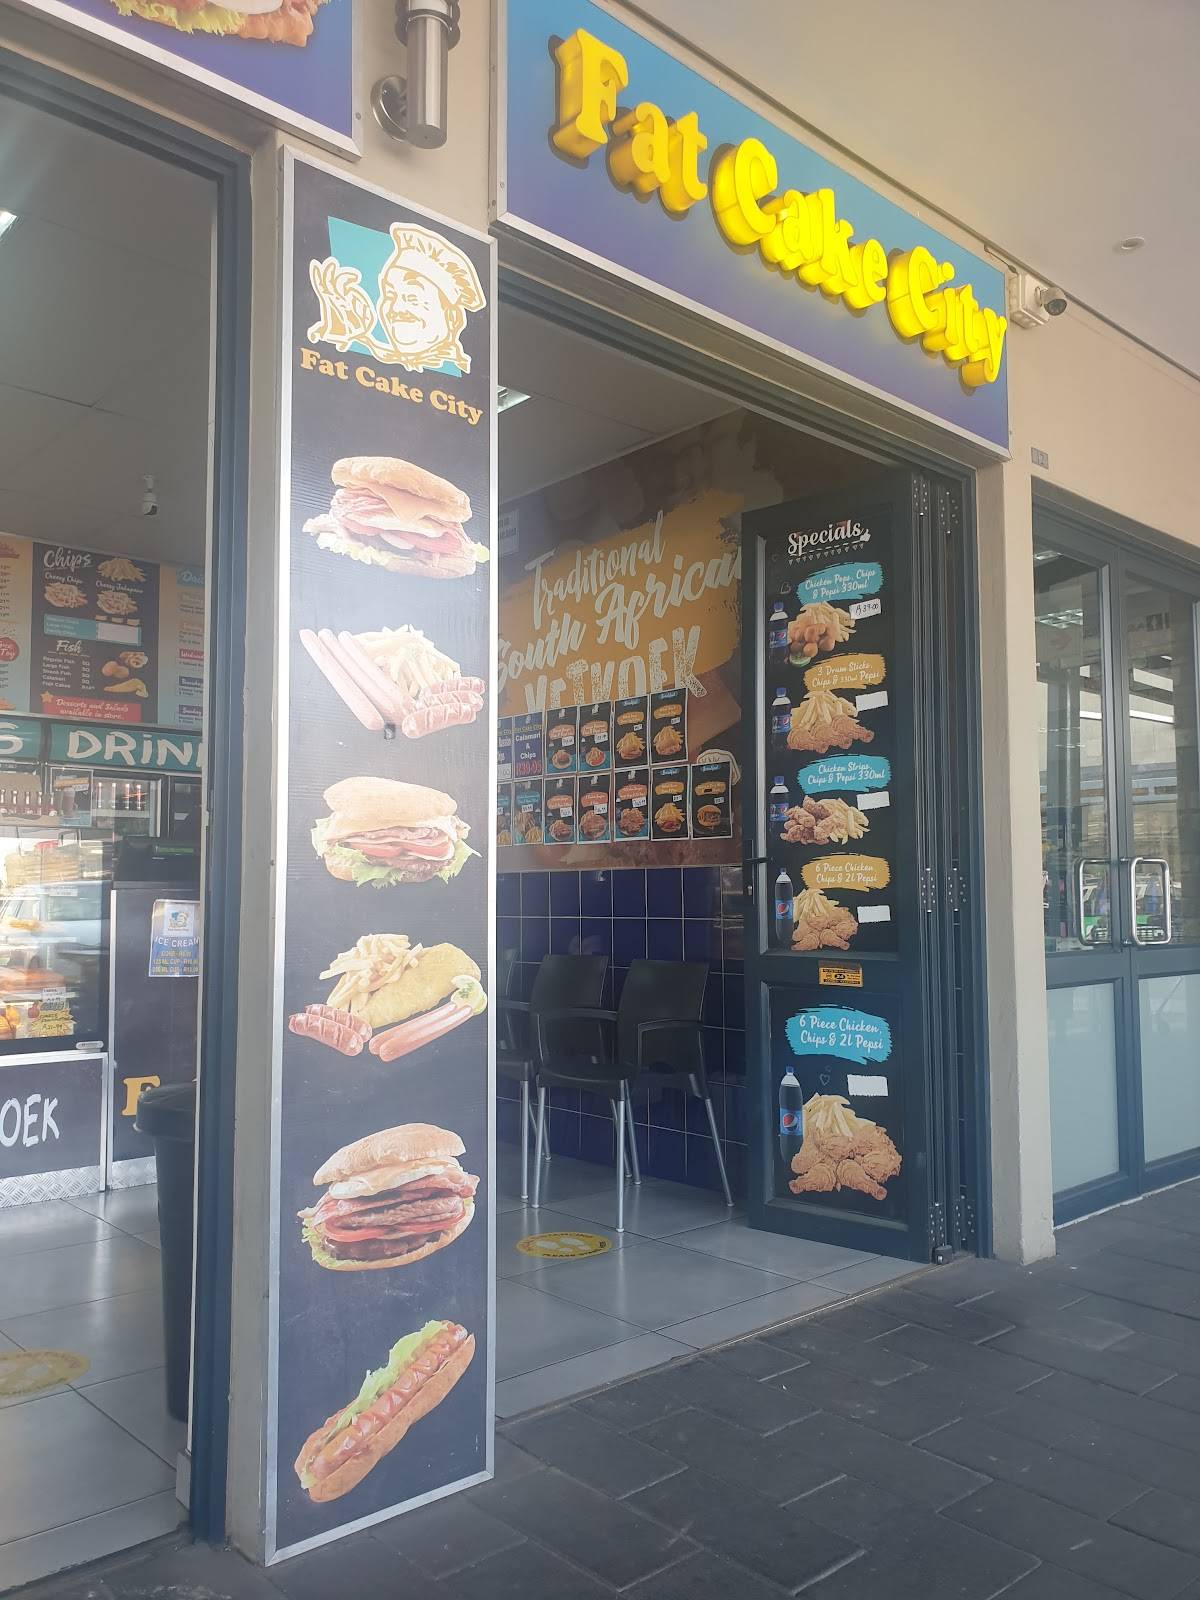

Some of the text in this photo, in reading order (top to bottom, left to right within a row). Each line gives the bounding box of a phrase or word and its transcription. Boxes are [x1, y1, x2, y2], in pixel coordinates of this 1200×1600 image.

[553, 28, 1008, 388] Fat Cake City
[300, 347, 484, 426] Fat Cake City
[788, 519, 863, 556] Specials
[44, 547, 92, 572] Chips
[525, 510, 666, 631] Traditional
[805, 578, 832, 590] Chicken
[857, 569, 876, 581] Chips
[821, 588, 839, 599] Pepsi
[841, 579, 868, 593] 330ml
[56, 640, 82, 653] Fish
[498, 612, 587, 695] South
[812, 677, 831, 688] Chips
[859, 670, 879, 682] Pepsi
[817, 666, 823, 676] 3
[826, 665, 847, 676] Drum
[56, 698, 87, 709] Desserts
[515, 731, 541, 742] Calamari
[520, 752, 537, 760] Chips
[808, 775, 827, 787] Chips
[837, 772, 856, 784] Pepsi
[857, 769, 885, 780] 330ml
[818, 764, 846, 774] Chicken
[816, 862, 873, 873] 6 Piece Chicken
[817, 873, 835, 885] Chips
[857, 872, 878, 885] Pepsi
[154, 935, 169, 946] ICE
[799, 1014, 882, 1035] 6 Piece Chicken,
[800, 1030, 828, 1048] Chips
[829, 1032, 837, 1046] &
[855, 1034, 884, 1053] Pepsi
